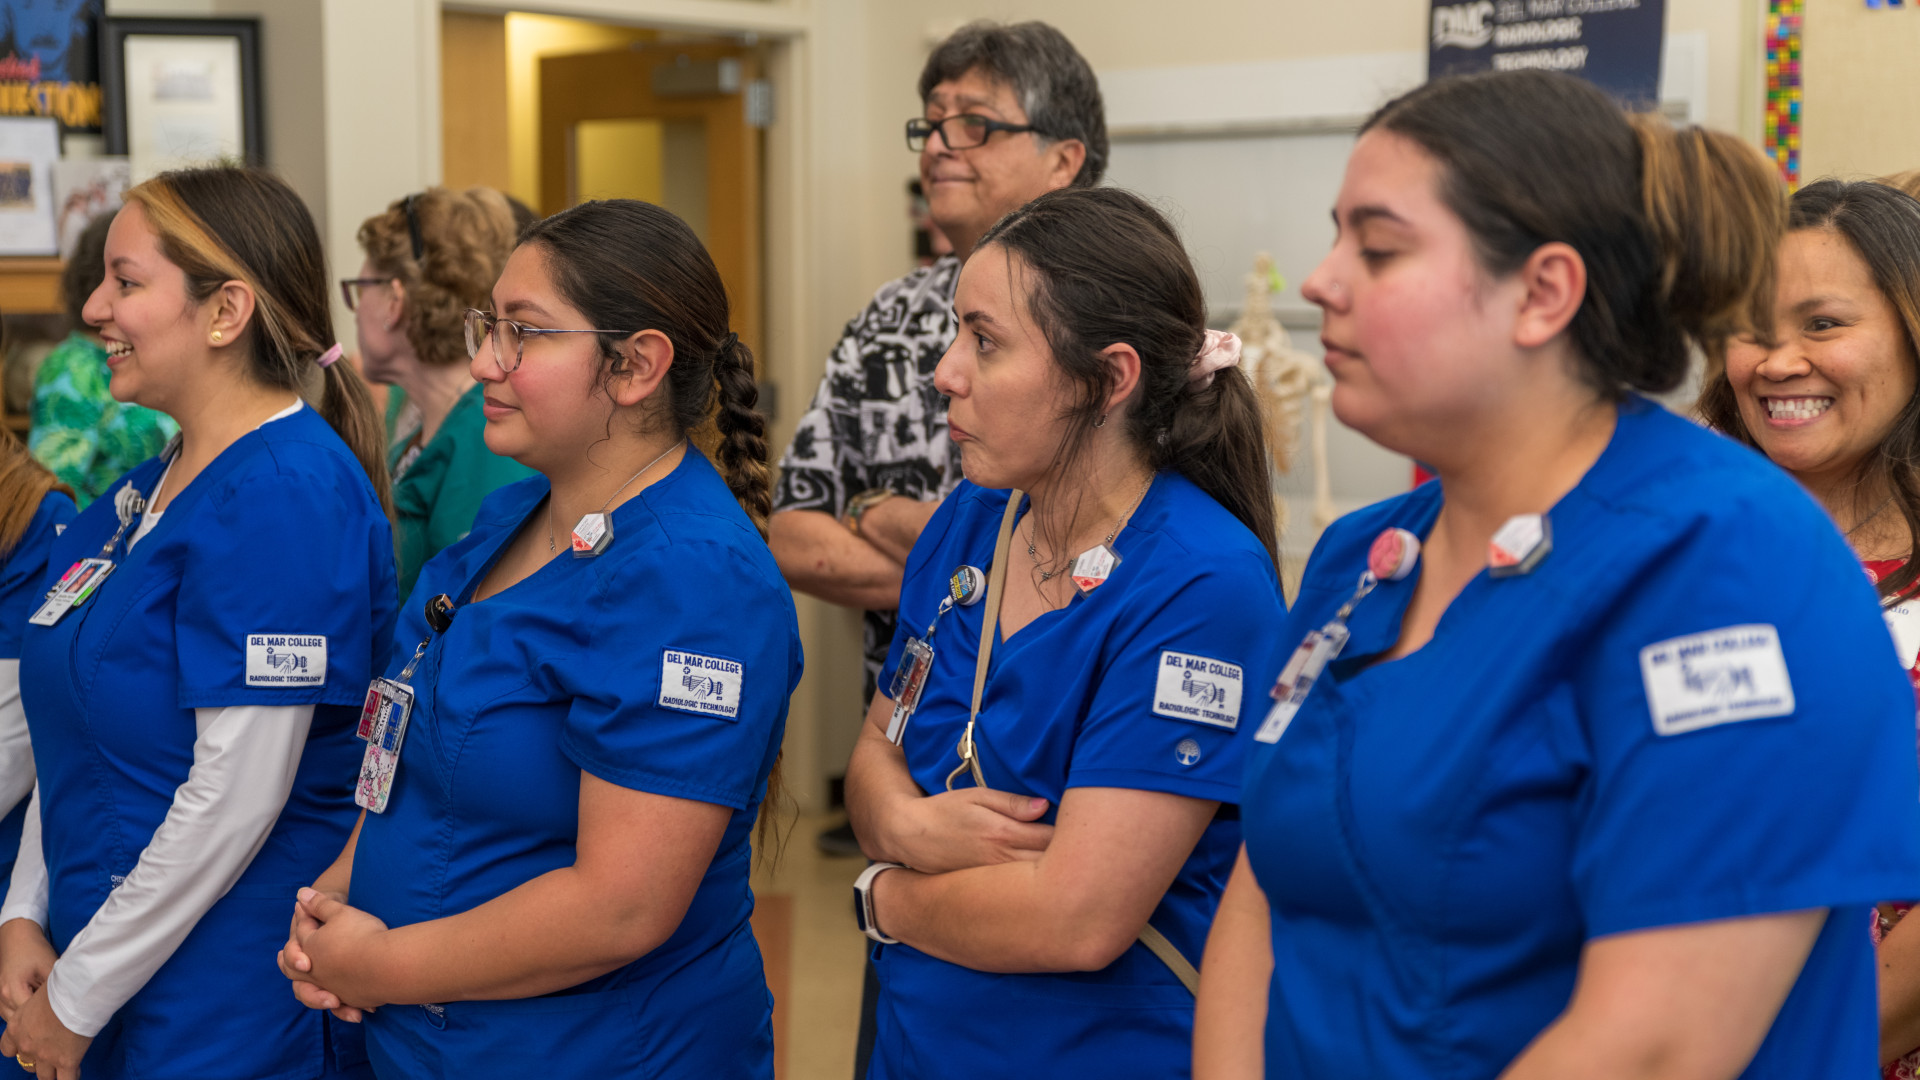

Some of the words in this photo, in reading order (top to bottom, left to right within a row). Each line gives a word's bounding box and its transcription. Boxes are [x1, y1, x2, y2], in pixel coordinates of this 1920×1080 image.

[1529, 0, 1563, 17] MAR
[1433, 2, 1494, 42] DMC
[1495, 17, 1582, 47] RADIOLOGIC
[1493, 45, 1588, 70] TECHNOLOGY
[251, 637, 265, 646] DEL
[267, 637, 286, 647] MAR
[288, 638, 323, 647] COLLEGE
[667, 653, 682, 664] DEL
[684, 655, 703, 668] MAR
[705, 659, 739, 674] COLLEGE
[1166, 655, 1183, 668] DEL
[1185, 658, 1207, 674] MAR
[1209, 663, 1241, 681] COLLEGE
[286, 675, 322, 683] TECHNOLOGY
[662, 696, 698, 708] RADIOLOGIC
[700, 702, 736, 714] TECHNOLOGY
[1159, 701, 1201, 717] RADIOLOGIC
[1202, 709, 1236, 723] TECHNOLOGY
